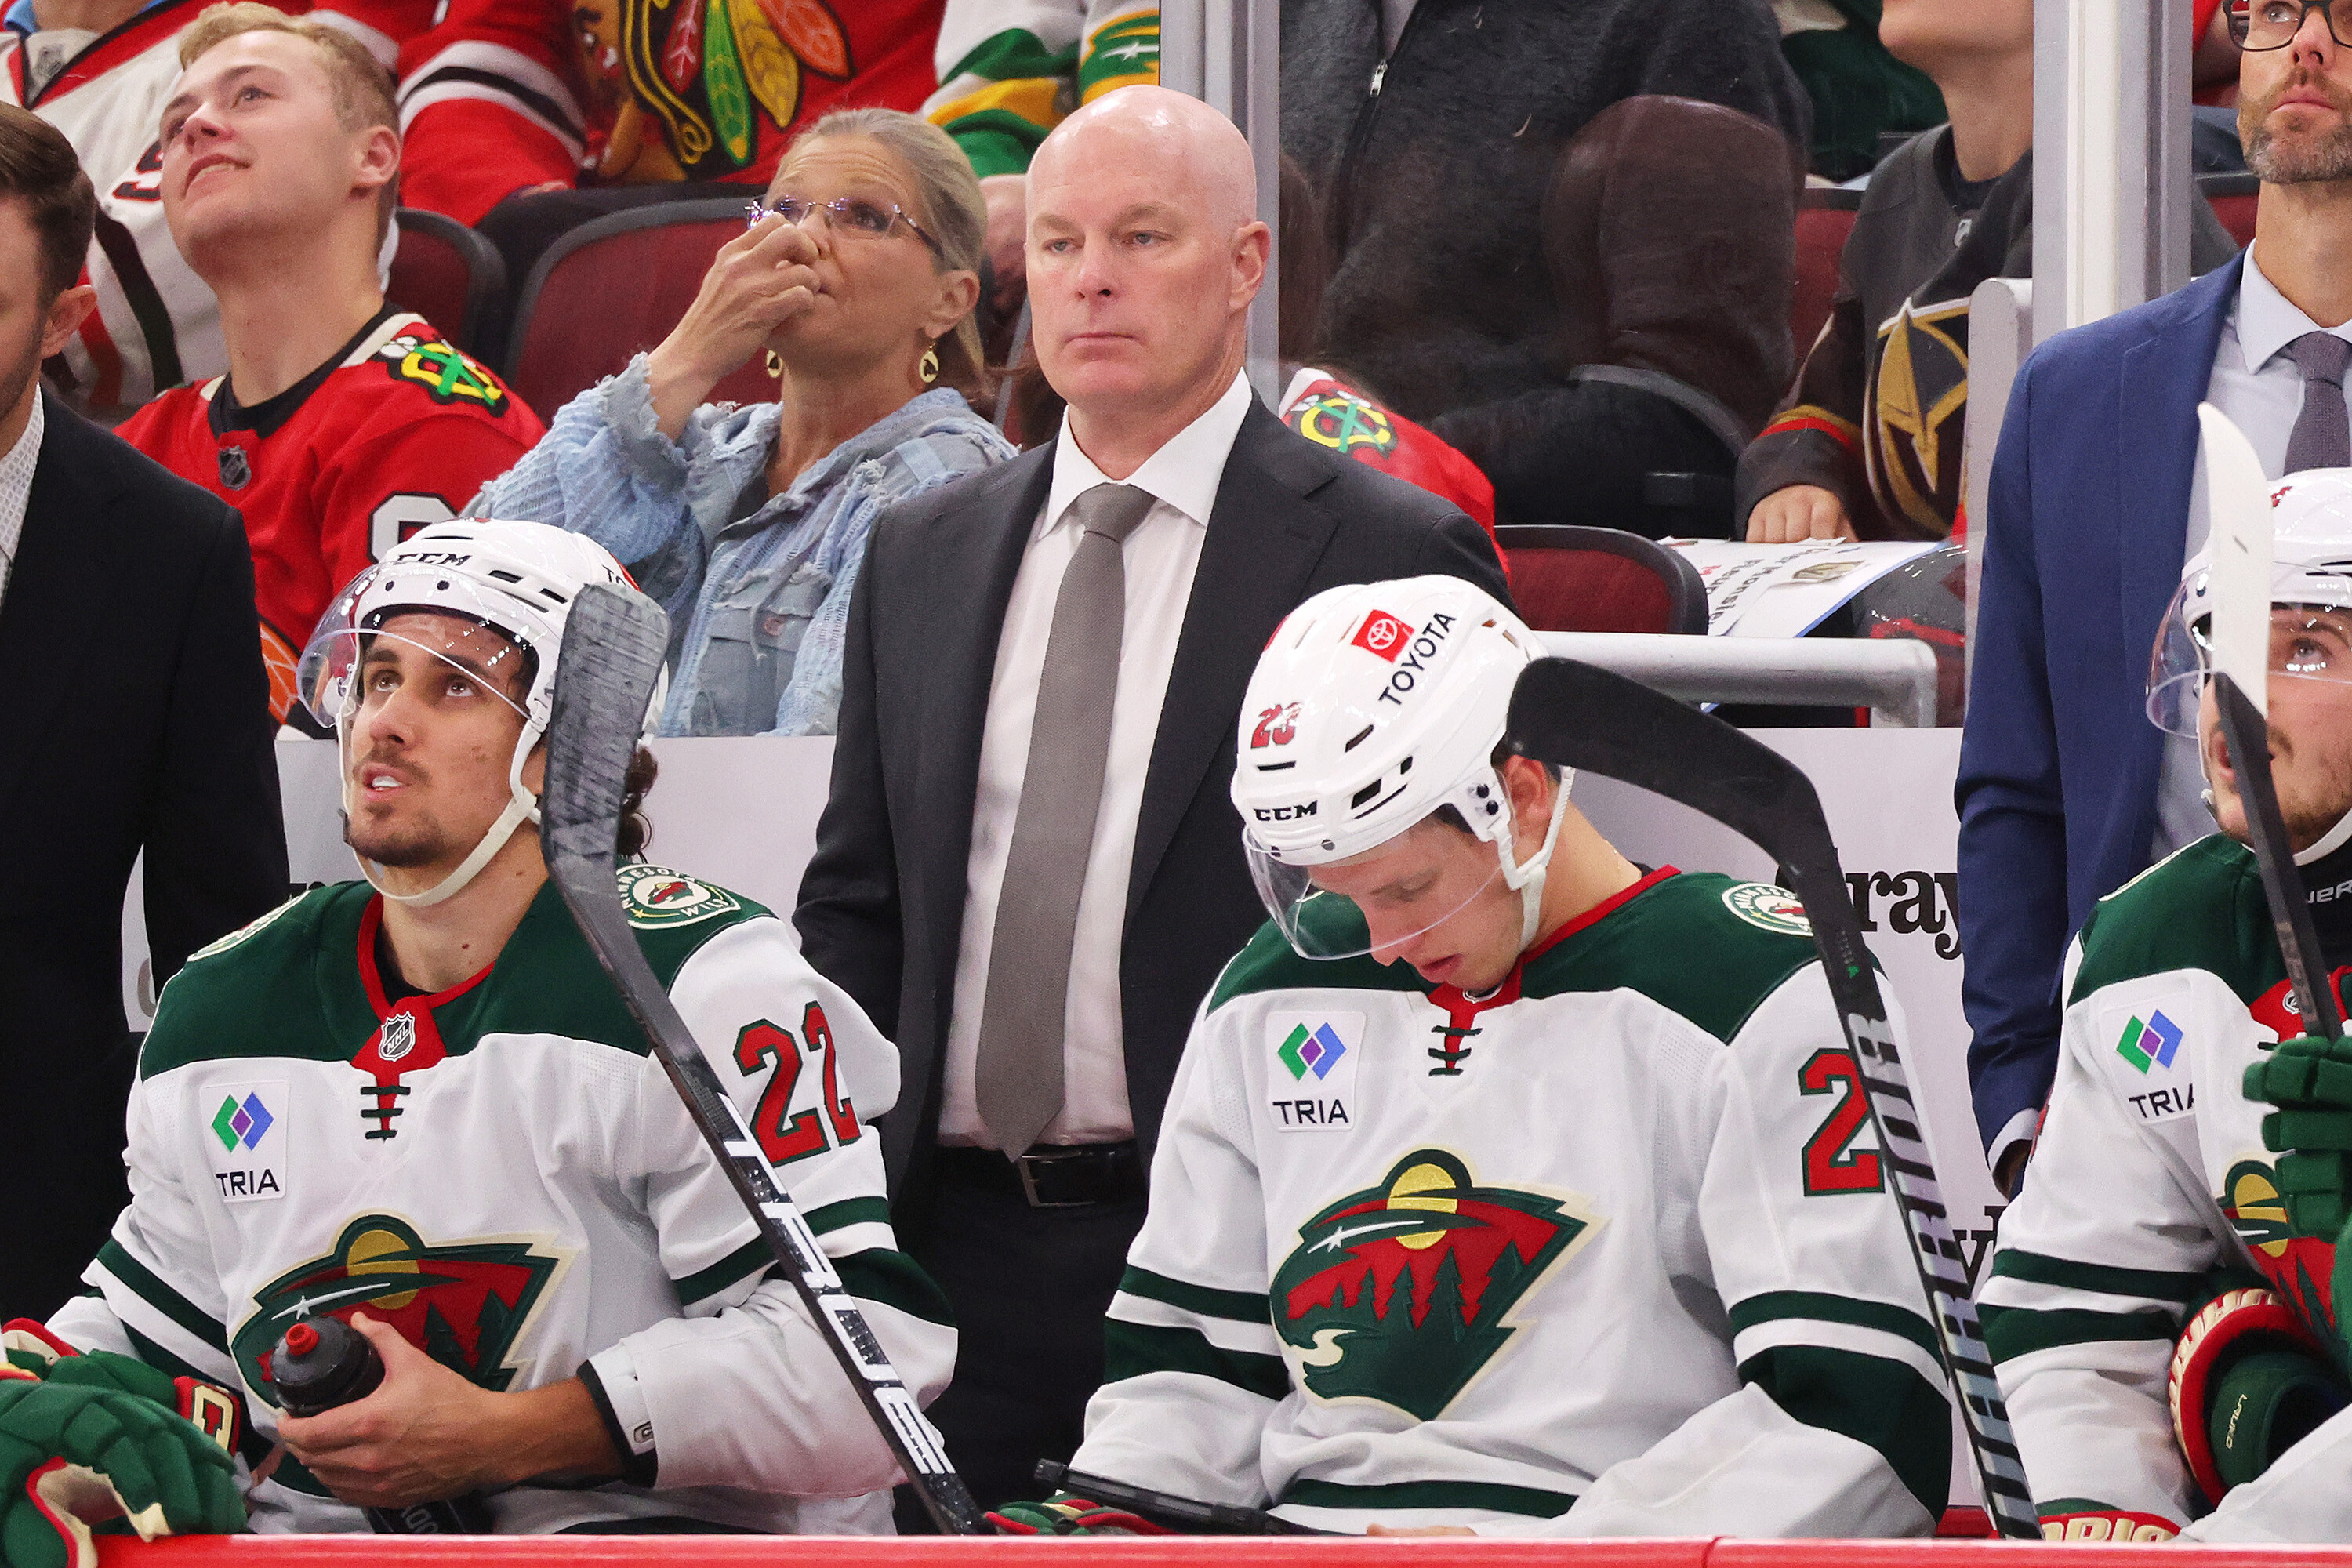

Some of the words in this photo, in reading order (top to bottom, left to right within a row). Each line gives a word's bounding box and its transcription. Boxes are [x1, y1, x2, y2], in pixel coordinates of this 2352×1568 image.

[1378, 612, 1457, 706] TOYOTA
[1253, 800, 1319, 822] CCM
[732, 1000, 862, 1169] 22
[1272, 1098, 1349, 1125] TRIA
[215, 1168, 281, 1197] TRIA
[716, 1091, 956, 1474] TRUE
